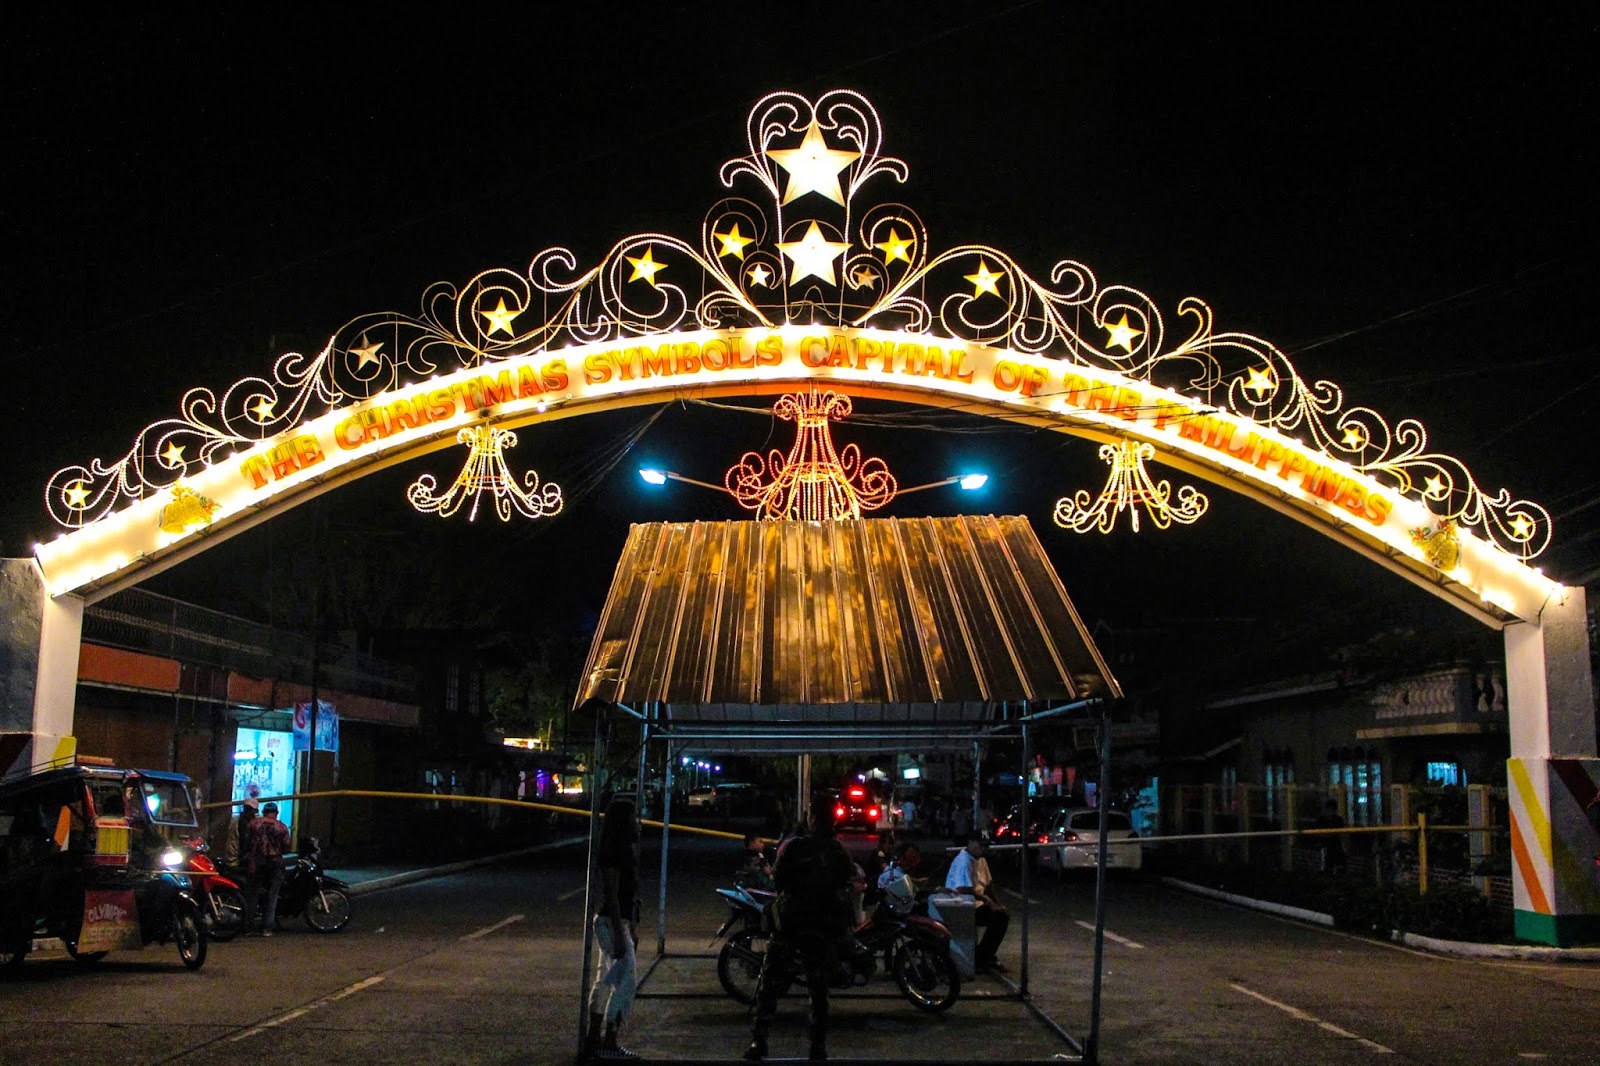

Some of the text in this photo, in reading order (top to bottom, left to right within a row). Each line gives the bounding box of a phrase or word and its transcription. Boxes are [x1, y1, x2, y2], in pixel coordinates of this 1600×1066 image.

[240, 334, 1393, 527] THE CHRISTMAS SYMBOLS CAPITAL OF THE PHILIPPINES
